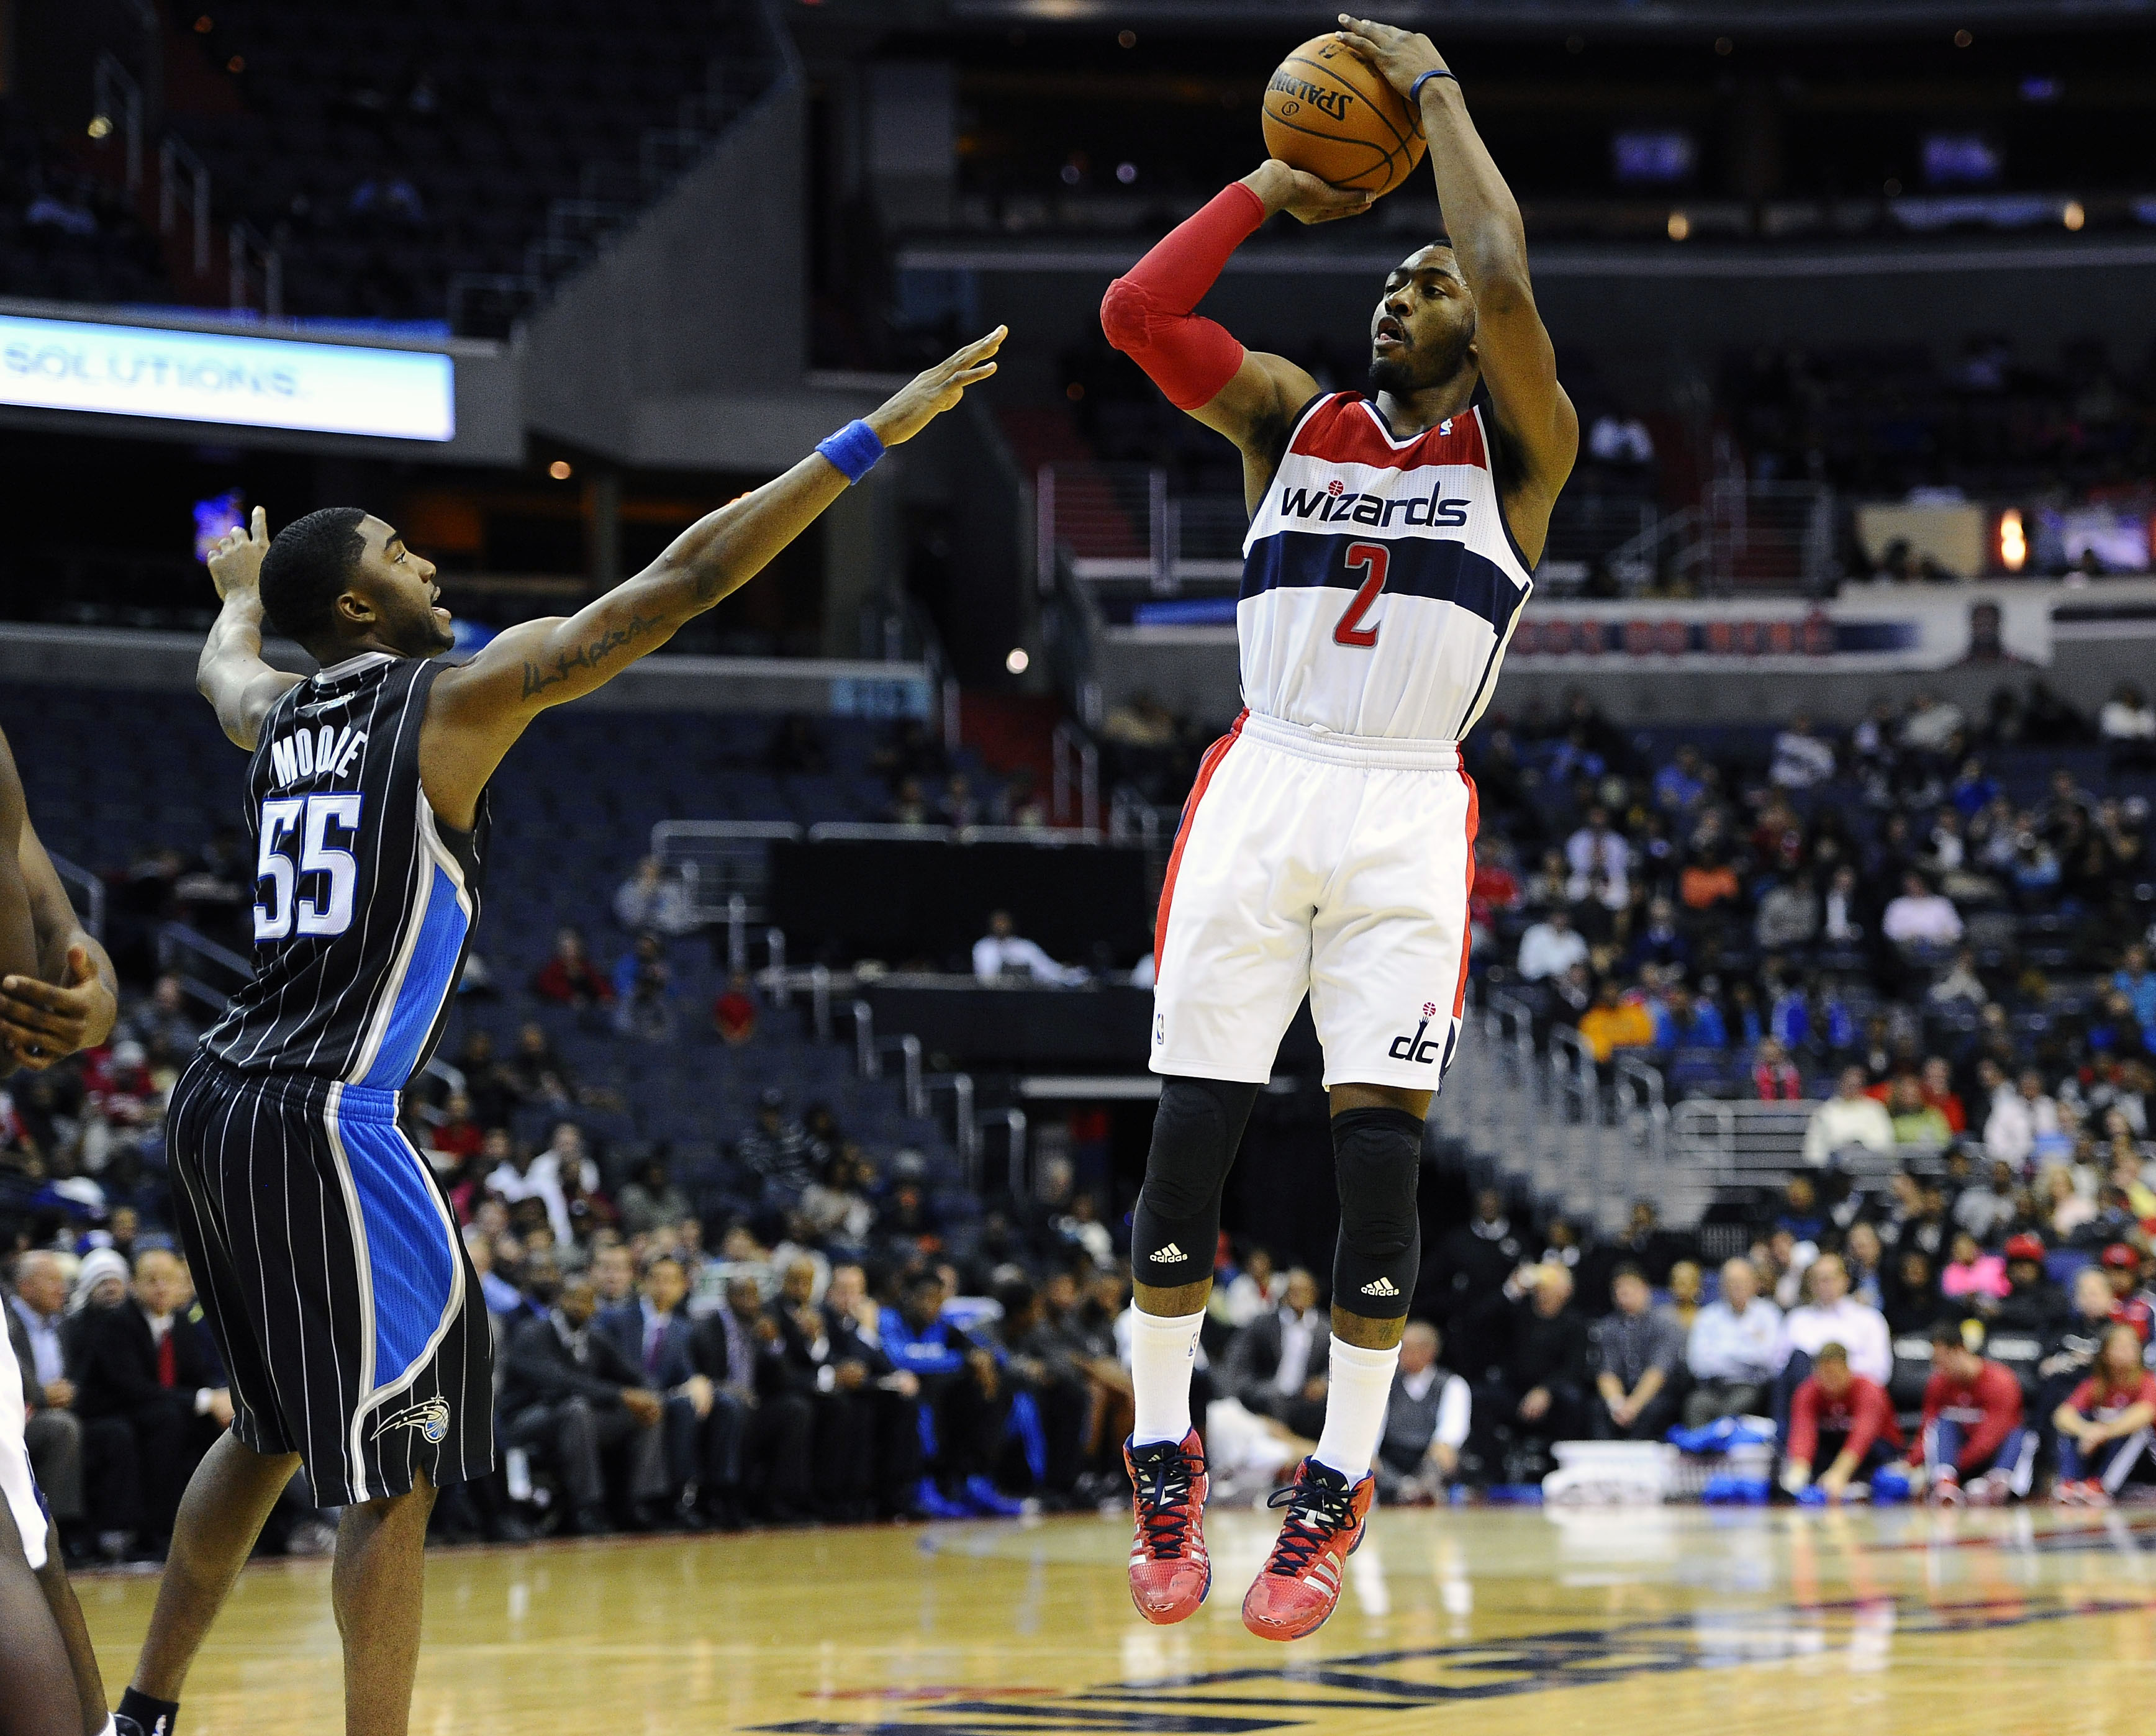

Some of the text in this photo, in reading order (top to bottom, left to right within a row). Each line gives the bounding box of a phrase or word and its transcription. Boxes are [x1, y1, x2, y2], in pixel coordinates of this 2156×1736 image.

[1267, 69, 1353, 120] SPALDIN
[1280, 480, 1472, 527] wizards
[1332, 541, 1390, 649] 2
[253, 792, 365, 943] 55
[1149, 1254, 1188, 1264] adidas
[1361, 1286, 1400, 1296] adidas
